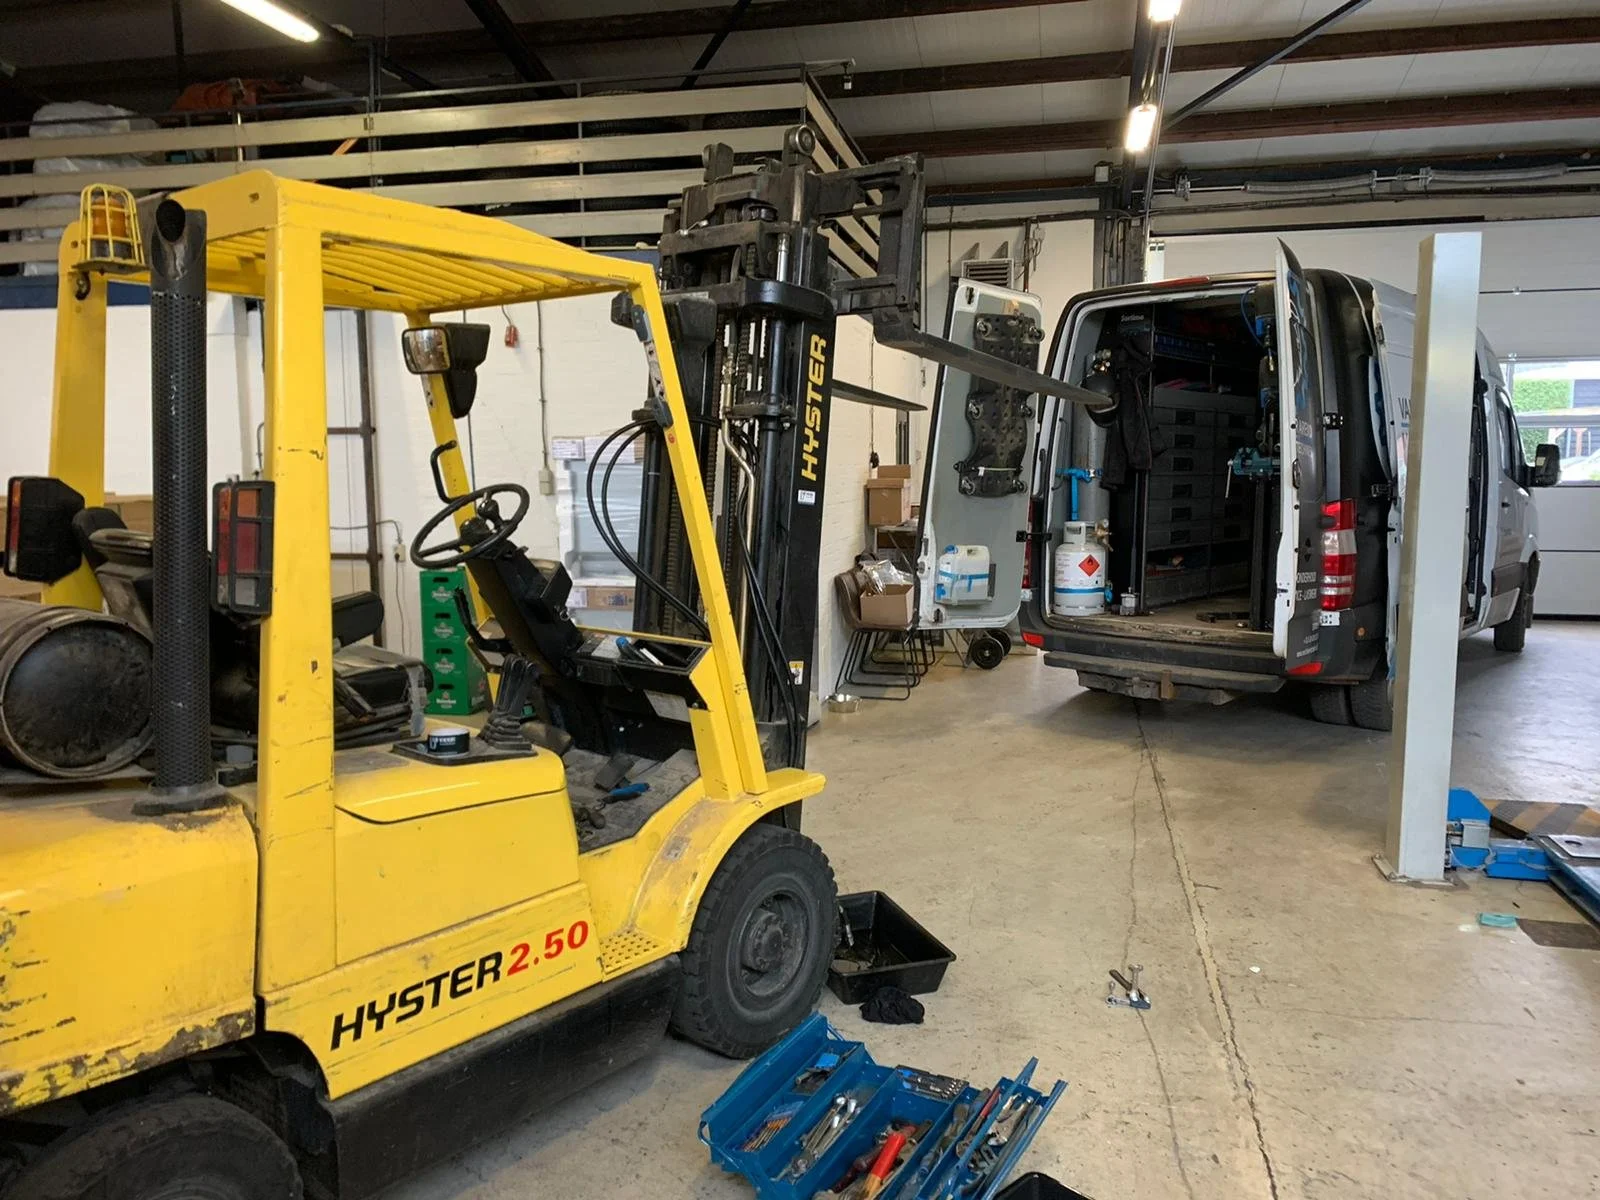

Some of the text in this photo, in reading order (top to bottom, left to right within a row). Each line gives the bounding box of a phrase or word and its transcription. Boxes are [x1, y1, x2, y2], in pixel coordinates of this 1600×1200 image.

[801, 333, 827, 482] HYSTER
[330, 920, 589, 1051] HYSTER 2.50
